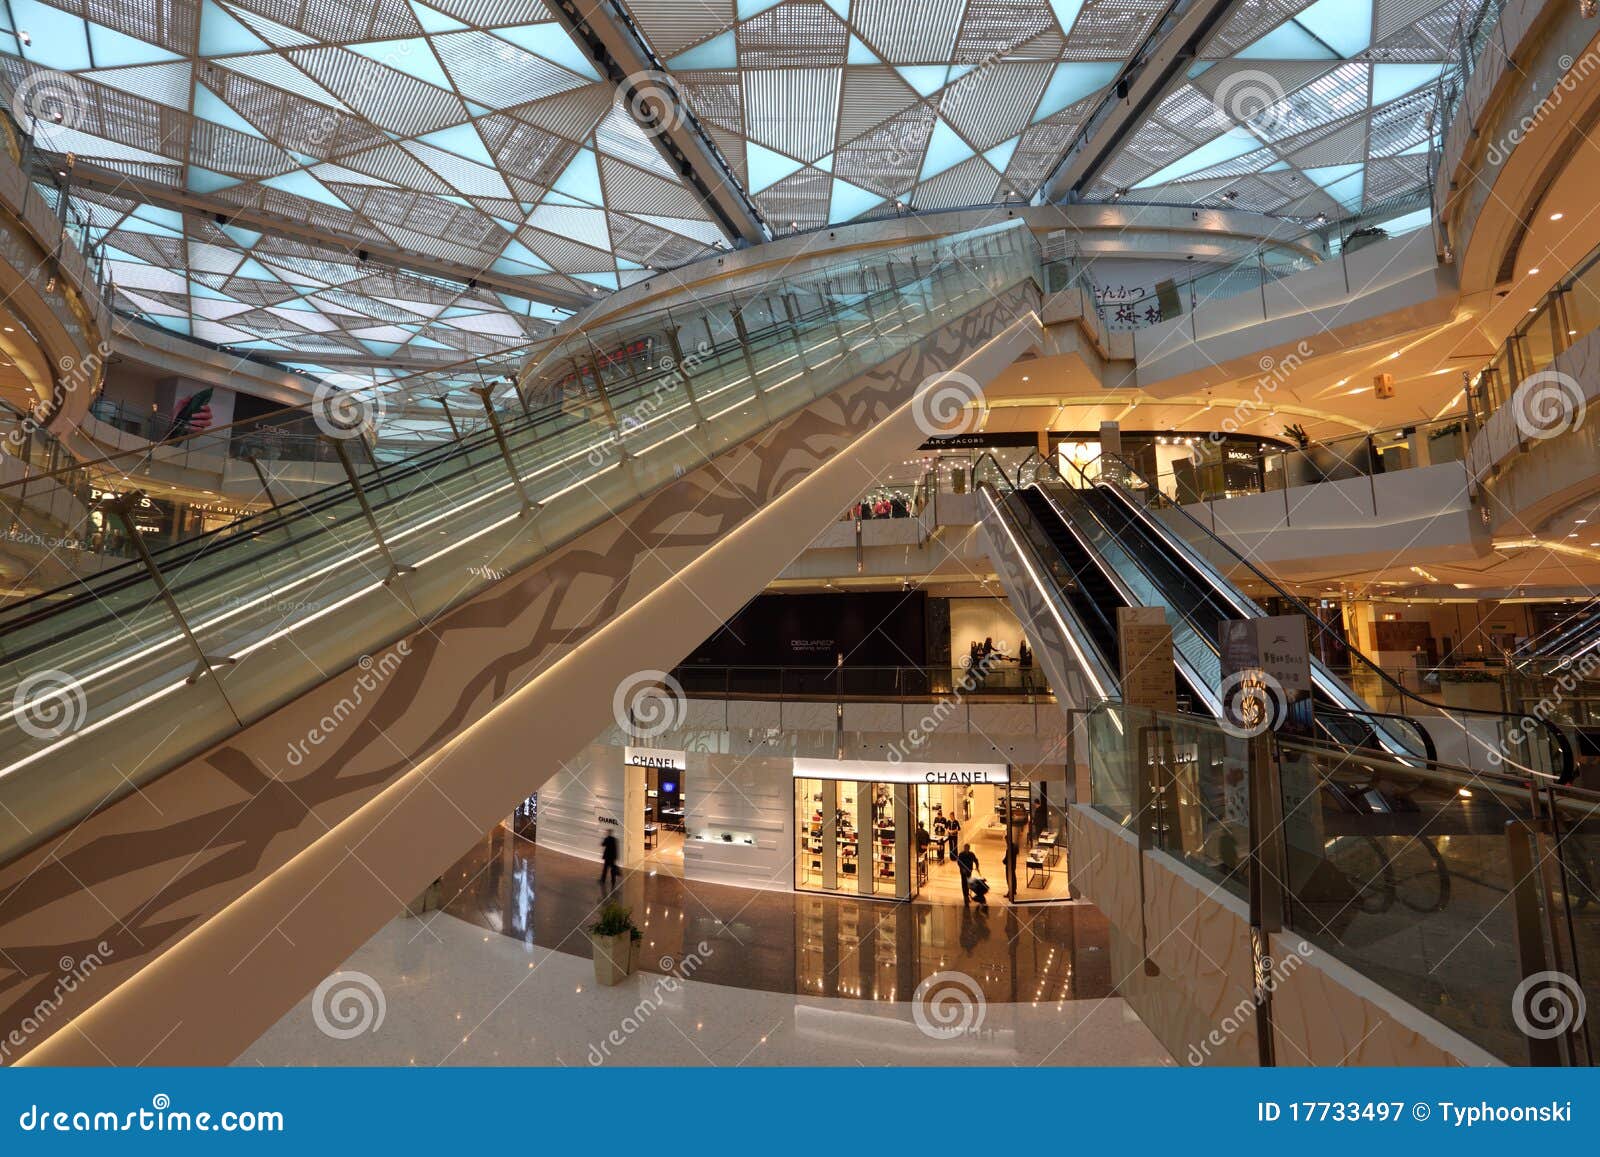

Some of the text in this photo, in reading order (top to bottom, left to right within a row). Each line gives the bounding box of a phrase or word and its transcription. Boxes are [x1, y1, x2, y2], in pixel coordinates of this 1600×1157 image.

[632, 755, 676, 769] CHANEL
[925, 771, 993, 784] CHANEL
[598, 816, 619, 826] CHANEL
